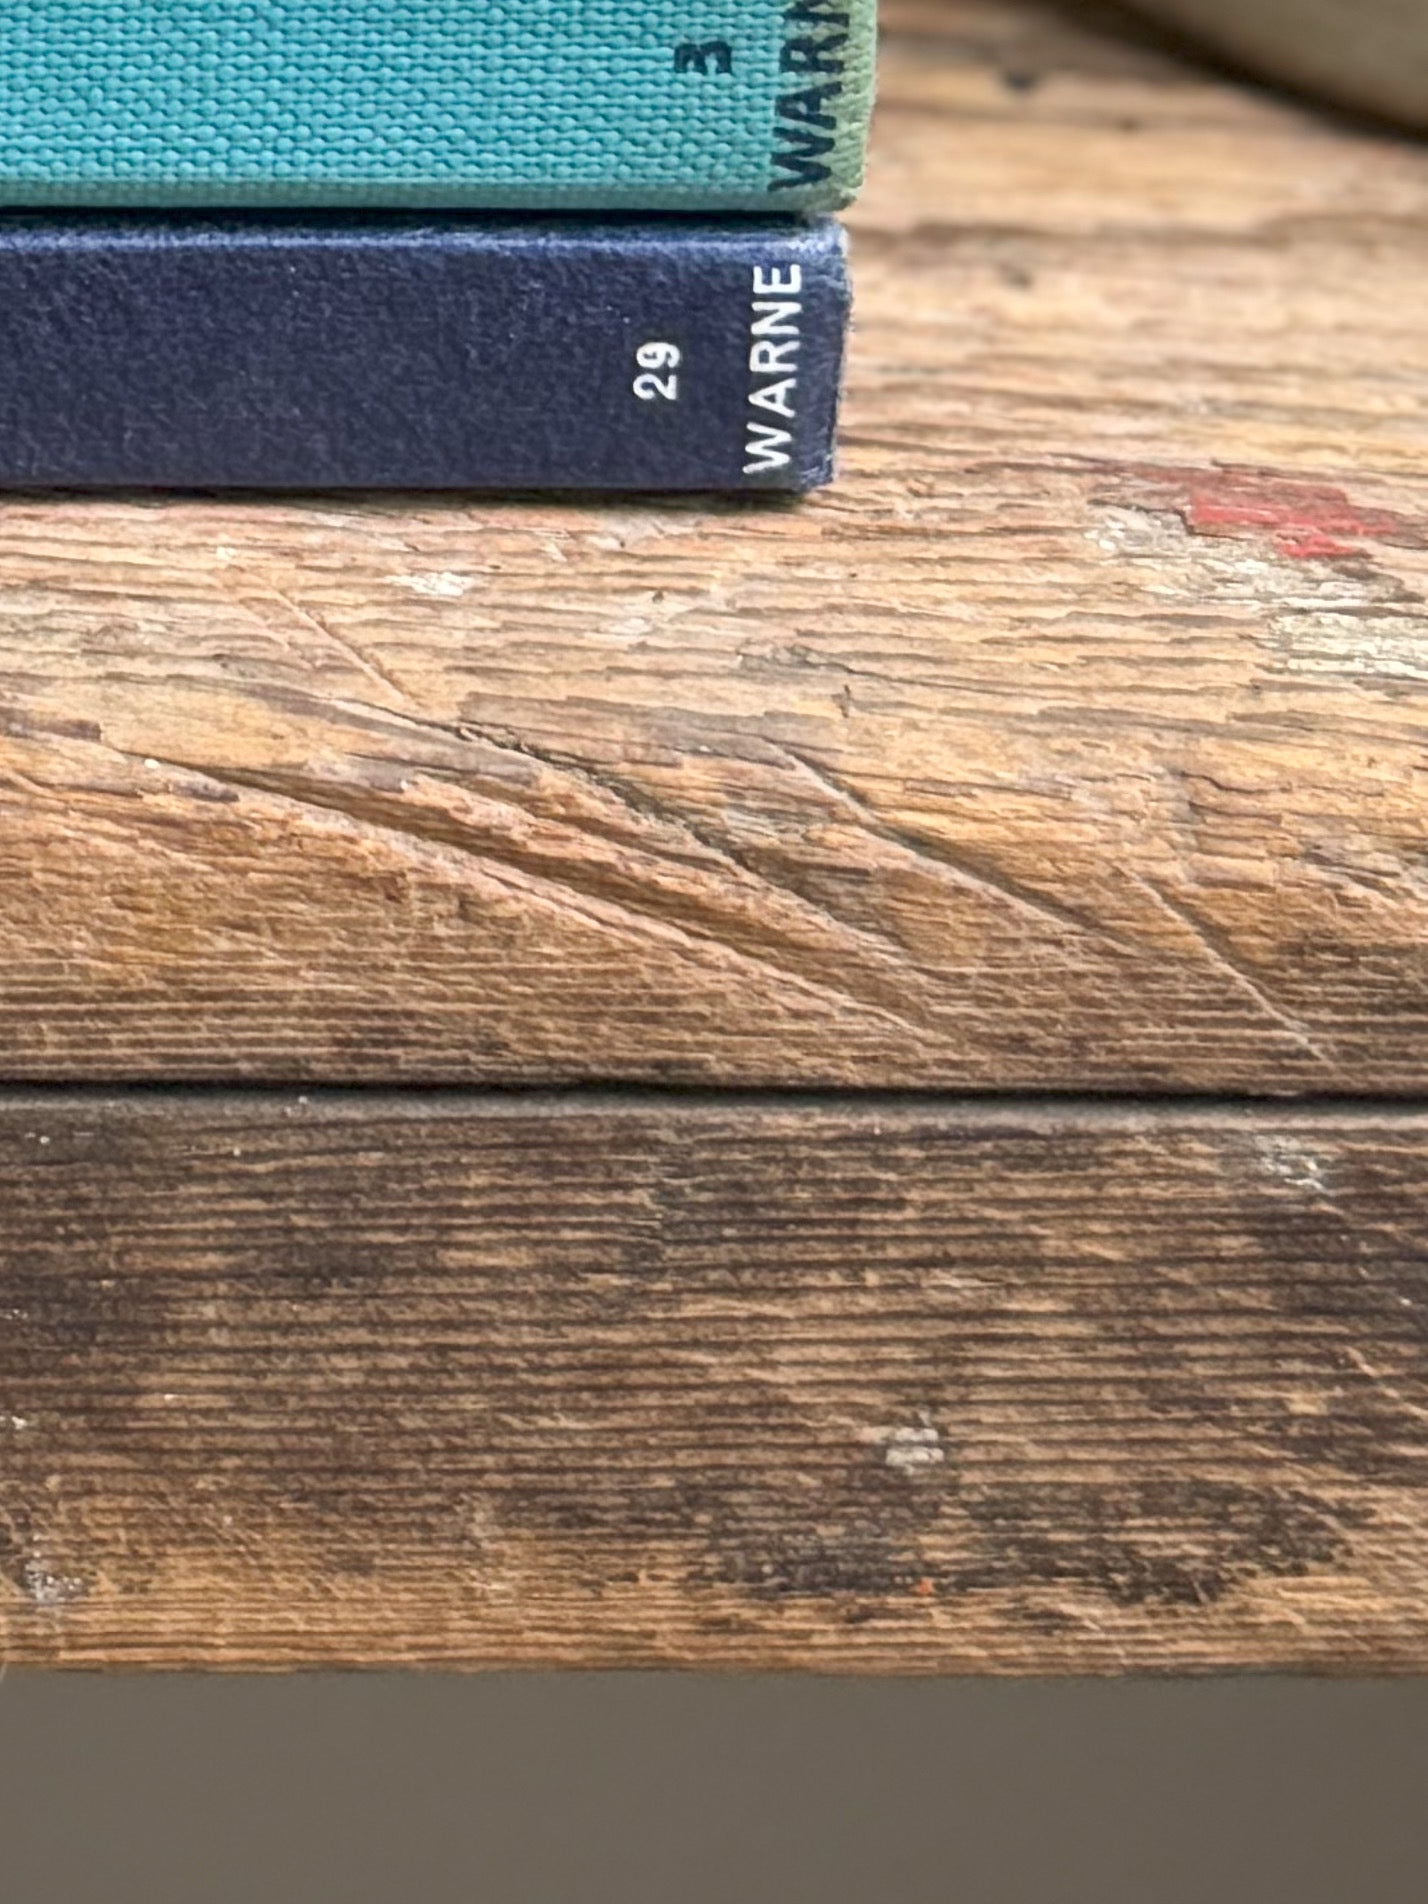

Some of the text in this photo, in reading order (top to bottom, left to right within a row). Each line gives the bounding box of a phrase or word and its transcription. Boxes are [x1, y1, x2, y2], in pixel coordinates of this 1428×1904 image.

[673, 41, 733, 75] 3
[632, 341, 681, 401] 29
[743, 263, 803, 476] WARNE
